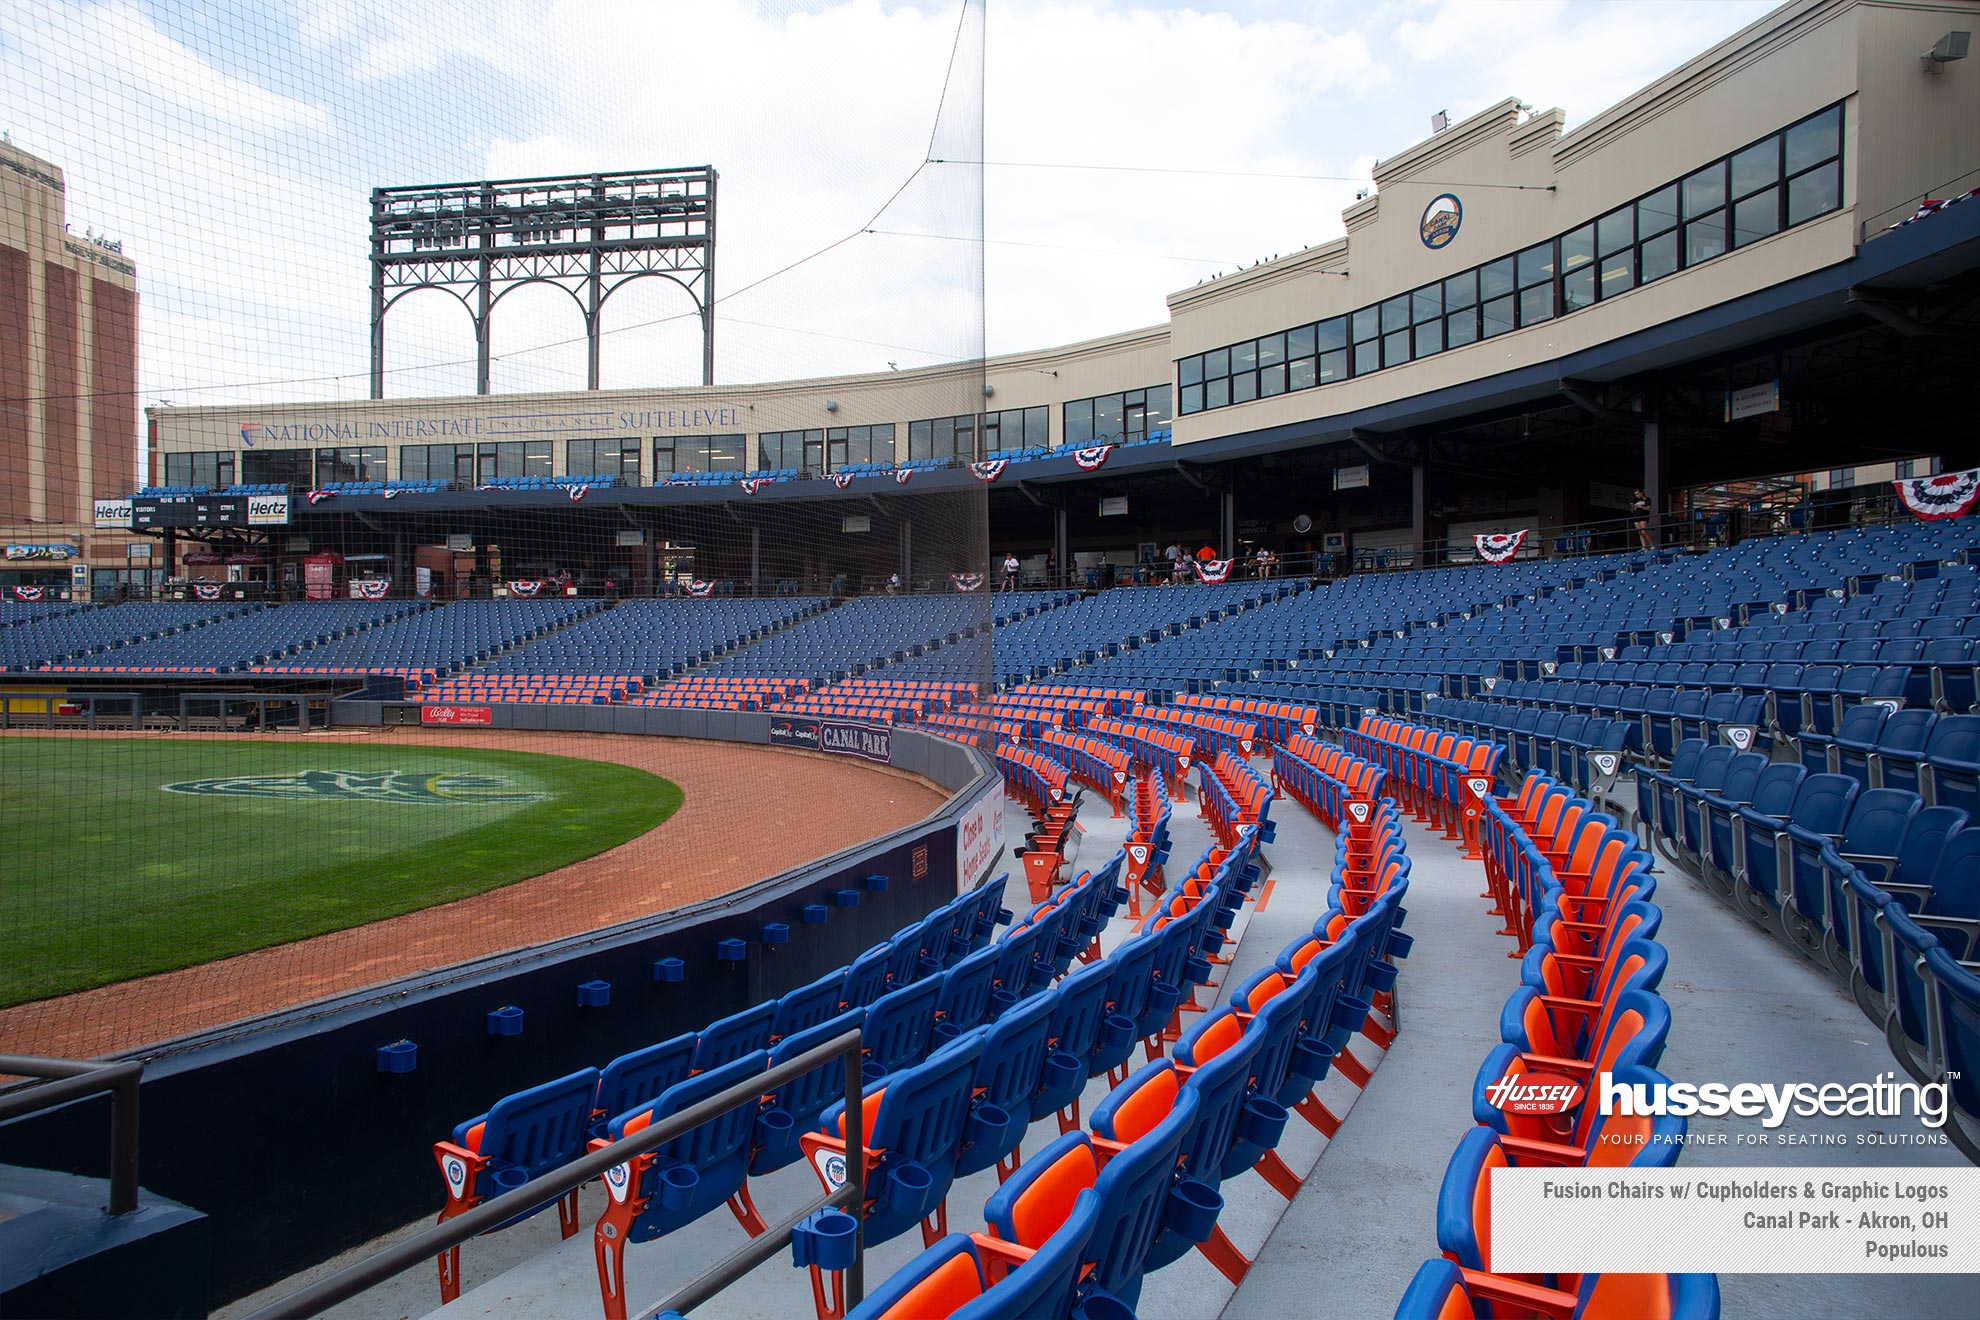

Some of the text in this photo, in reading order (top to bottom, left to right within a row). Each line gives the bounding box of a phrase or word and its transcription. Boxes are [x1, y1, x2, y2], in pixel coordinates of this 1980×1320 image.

[264, 408, 741, 442] NATIONAL INTERSTATE INSURANCE SUITE LEVEL
[96, 505, 132, 518] Hertz
[250, 502, 287, 515] Hertz
[823, 727, 889, 757] CANAL PARK
[963, 820, 977, 852] Close
[963, 851, 978, 887] Home
